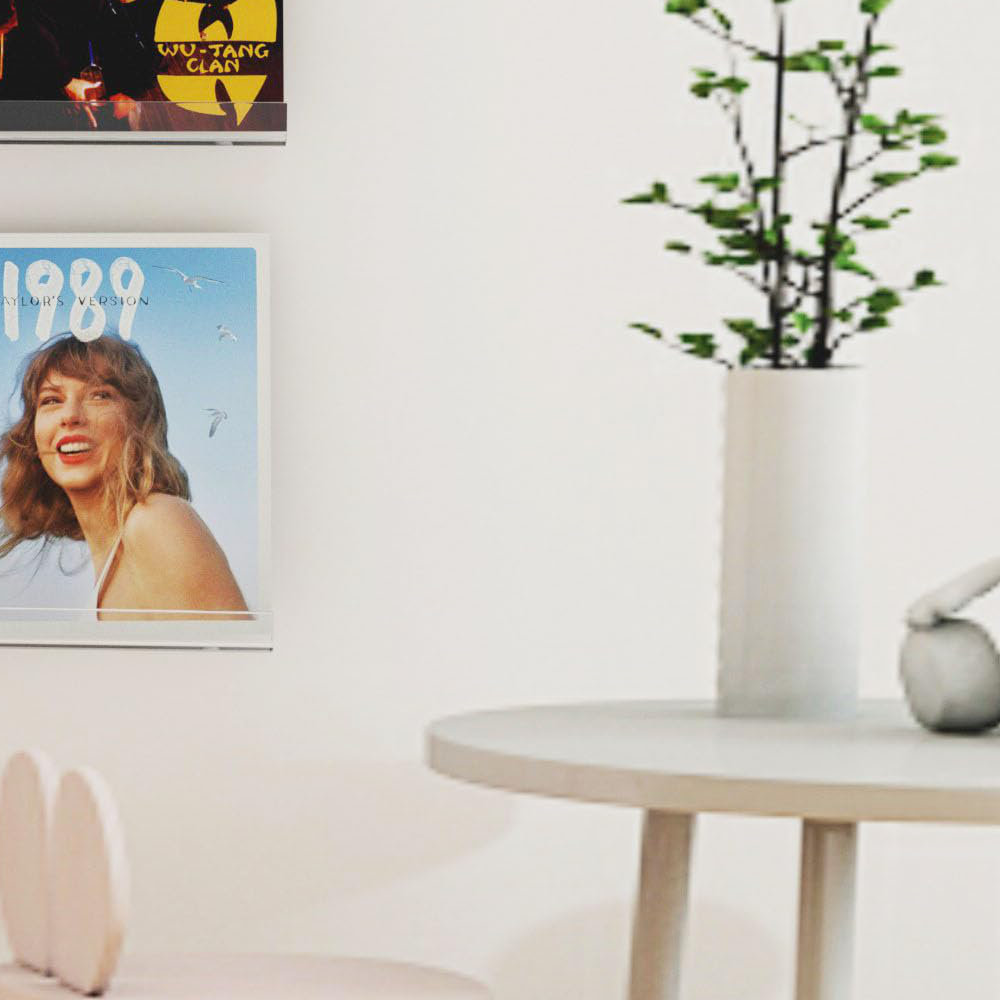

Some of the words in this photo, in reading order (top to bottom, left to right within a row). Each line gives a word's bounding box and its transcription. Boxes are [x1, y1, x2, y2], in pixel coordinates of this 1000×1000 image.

[157, 43, 270, 59] WU-TANG
[186, 58, 240, 73] CLAN
[2, 256, 146, 343] 1989
[78, 295, 150, 307] VERSION
